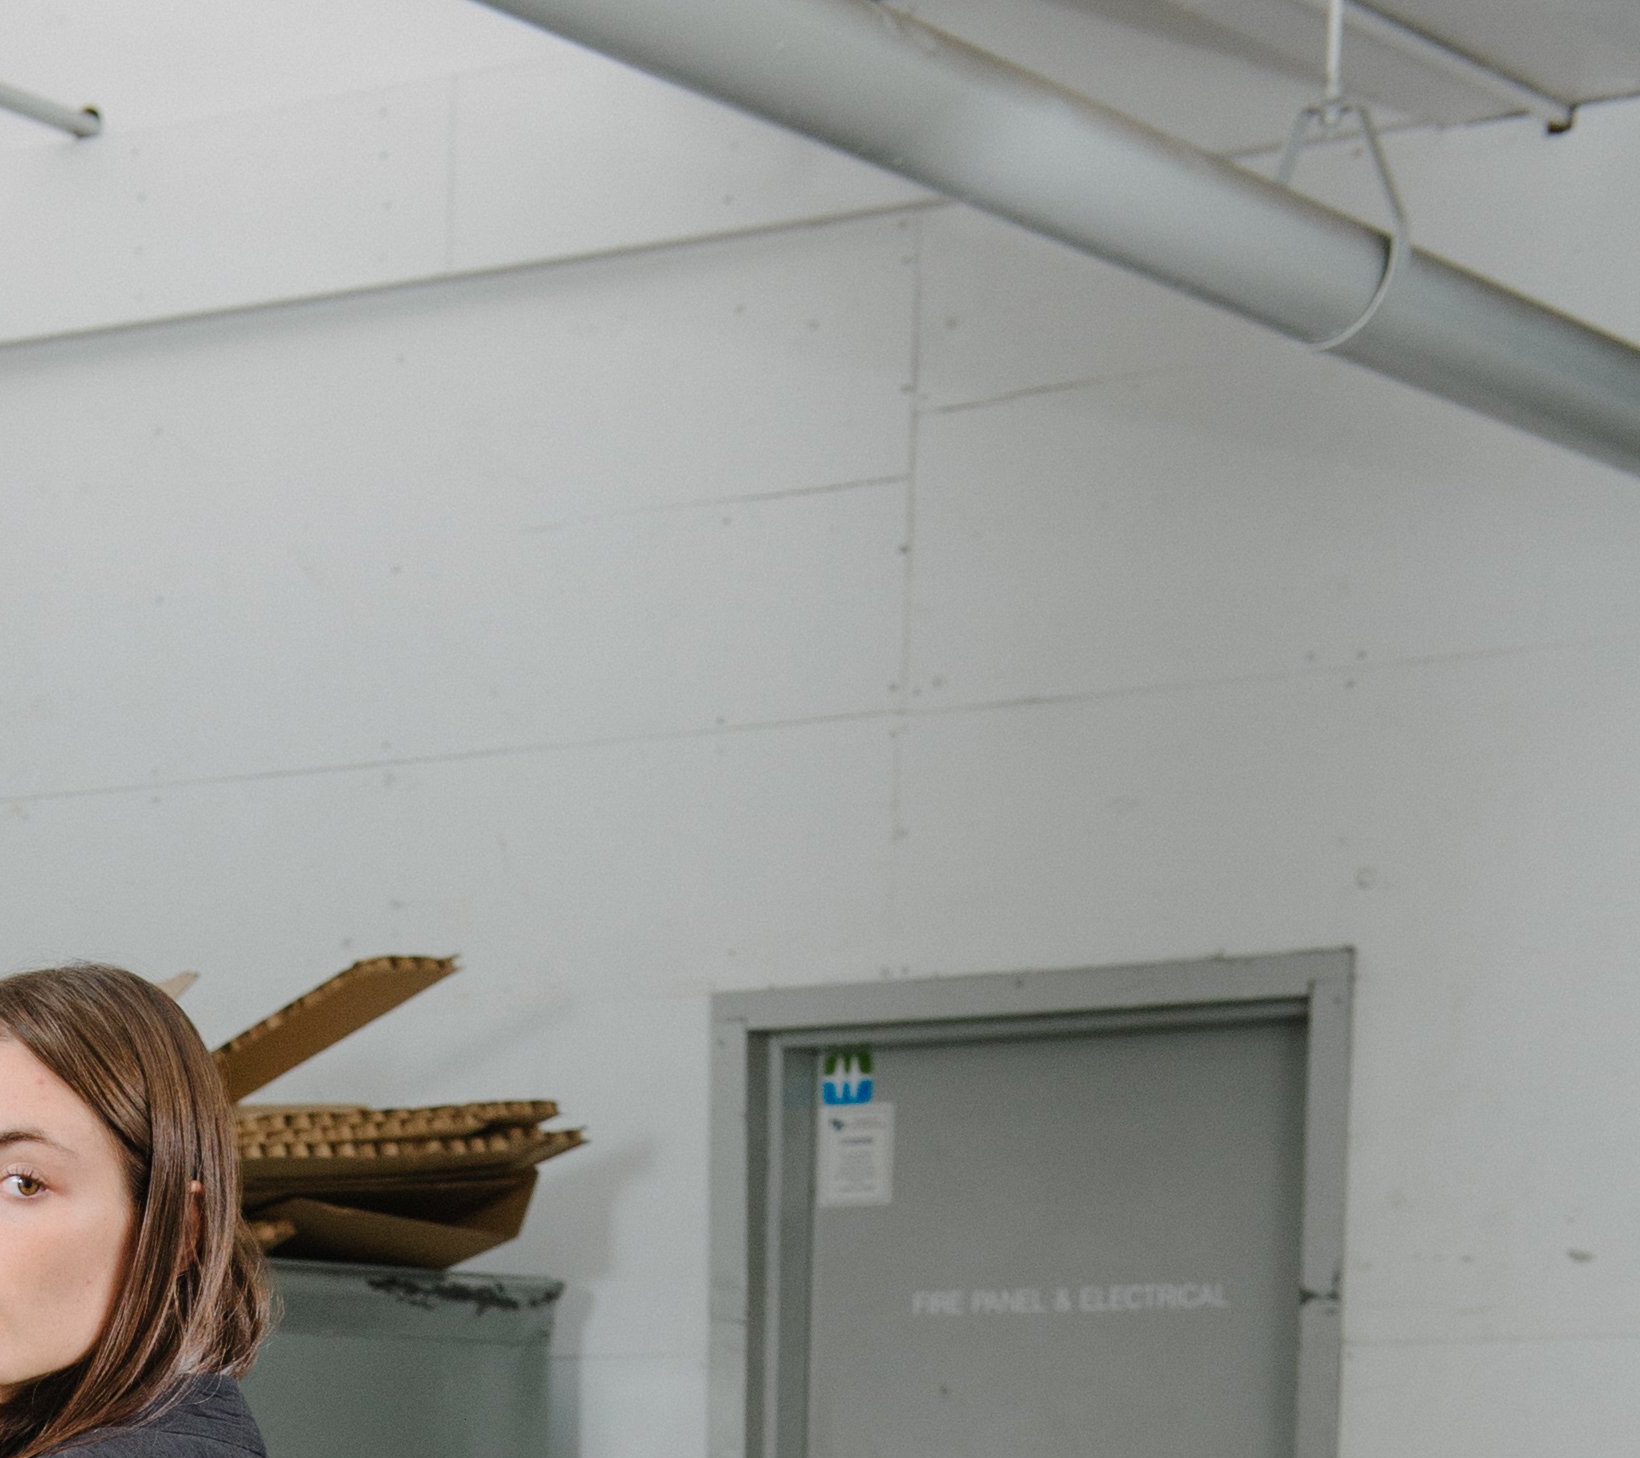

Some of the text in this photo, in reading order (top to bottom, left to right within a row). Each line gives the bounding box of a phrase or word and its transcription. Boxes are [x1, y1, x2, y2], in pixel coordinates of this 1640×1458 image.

[912, 1282, 1227, 1314] FIRE PANEL & ELECTRICAL
